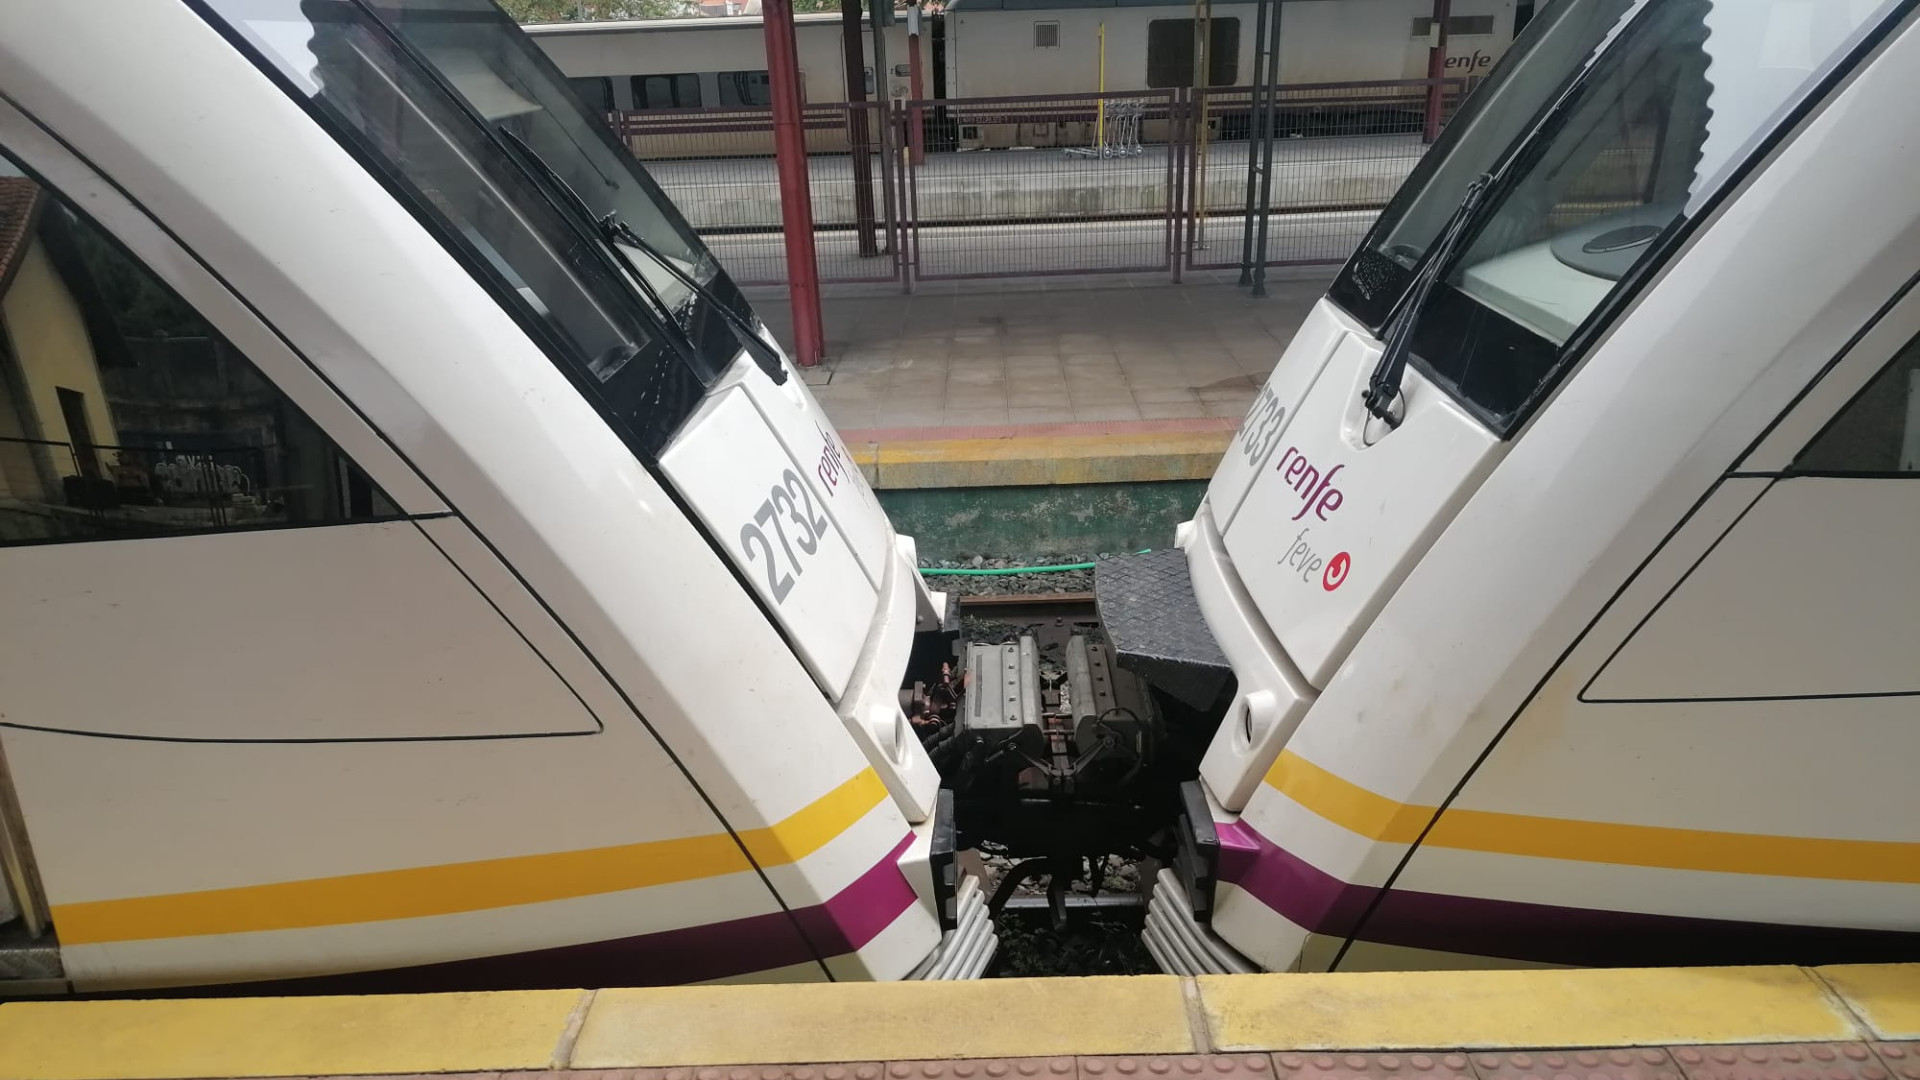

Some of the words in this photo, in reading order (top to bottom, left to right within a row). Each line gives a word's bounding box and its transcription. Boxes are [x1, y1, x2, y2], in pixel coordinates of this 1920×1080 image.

[1444, 49, 1491, 74] enfe
[1276, 446, 1346, 522] renfe
[740, 468, 829, 605] 2732
[1277, 527, 1323, 584] feve
